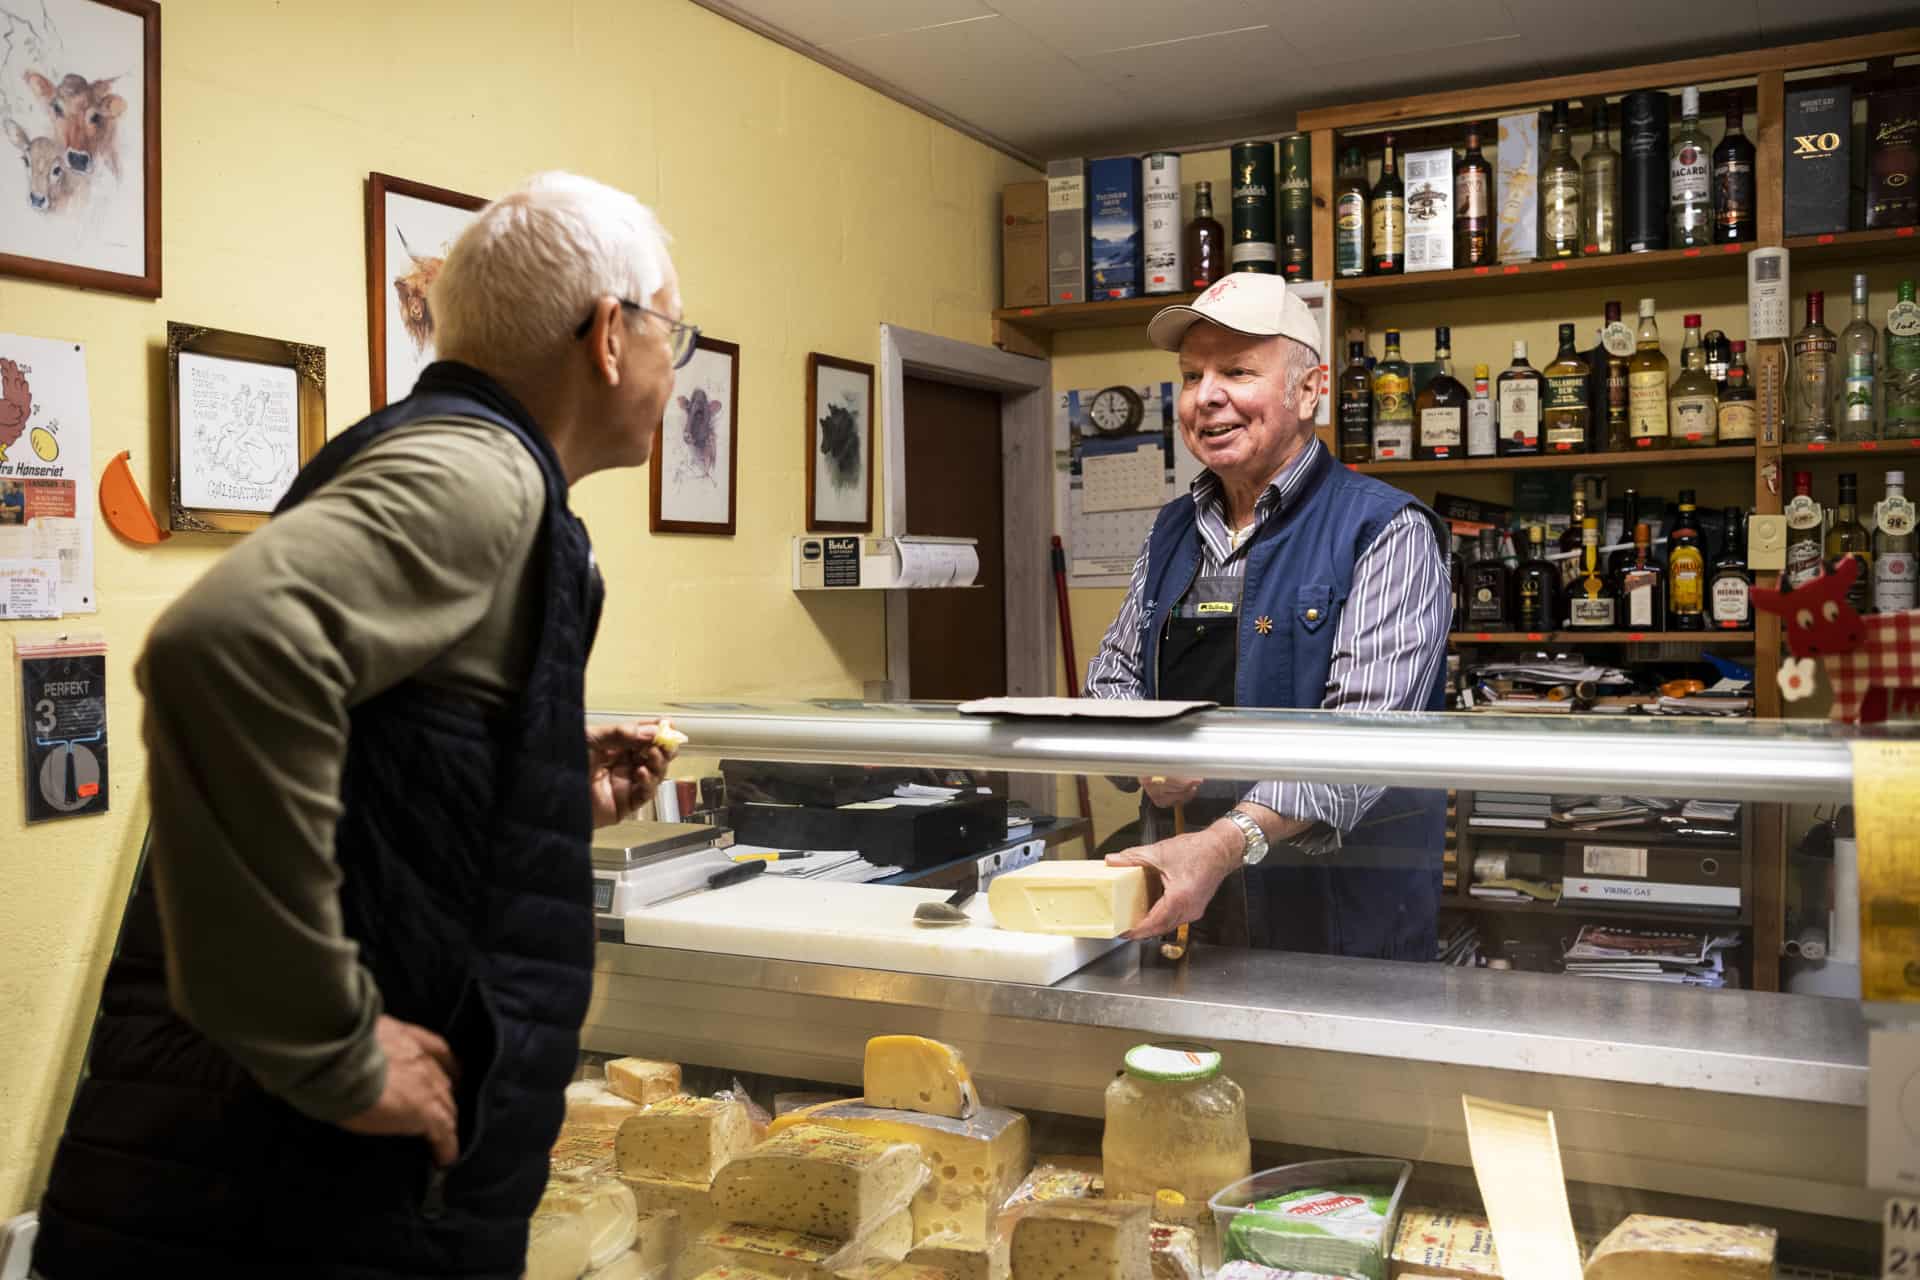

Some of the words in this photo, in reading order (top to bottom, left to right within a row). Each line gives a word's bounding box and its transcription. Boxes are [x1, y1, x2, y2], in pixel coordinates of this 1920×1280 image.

[1793, 132, 1840, 154] XO
[44, 681, 90, 697] PERFEKT
[35, 699, 57, 733] 3
[1603, 886, 1632, 896] VIKING
[1633, 887, 1651, 897] GAS
